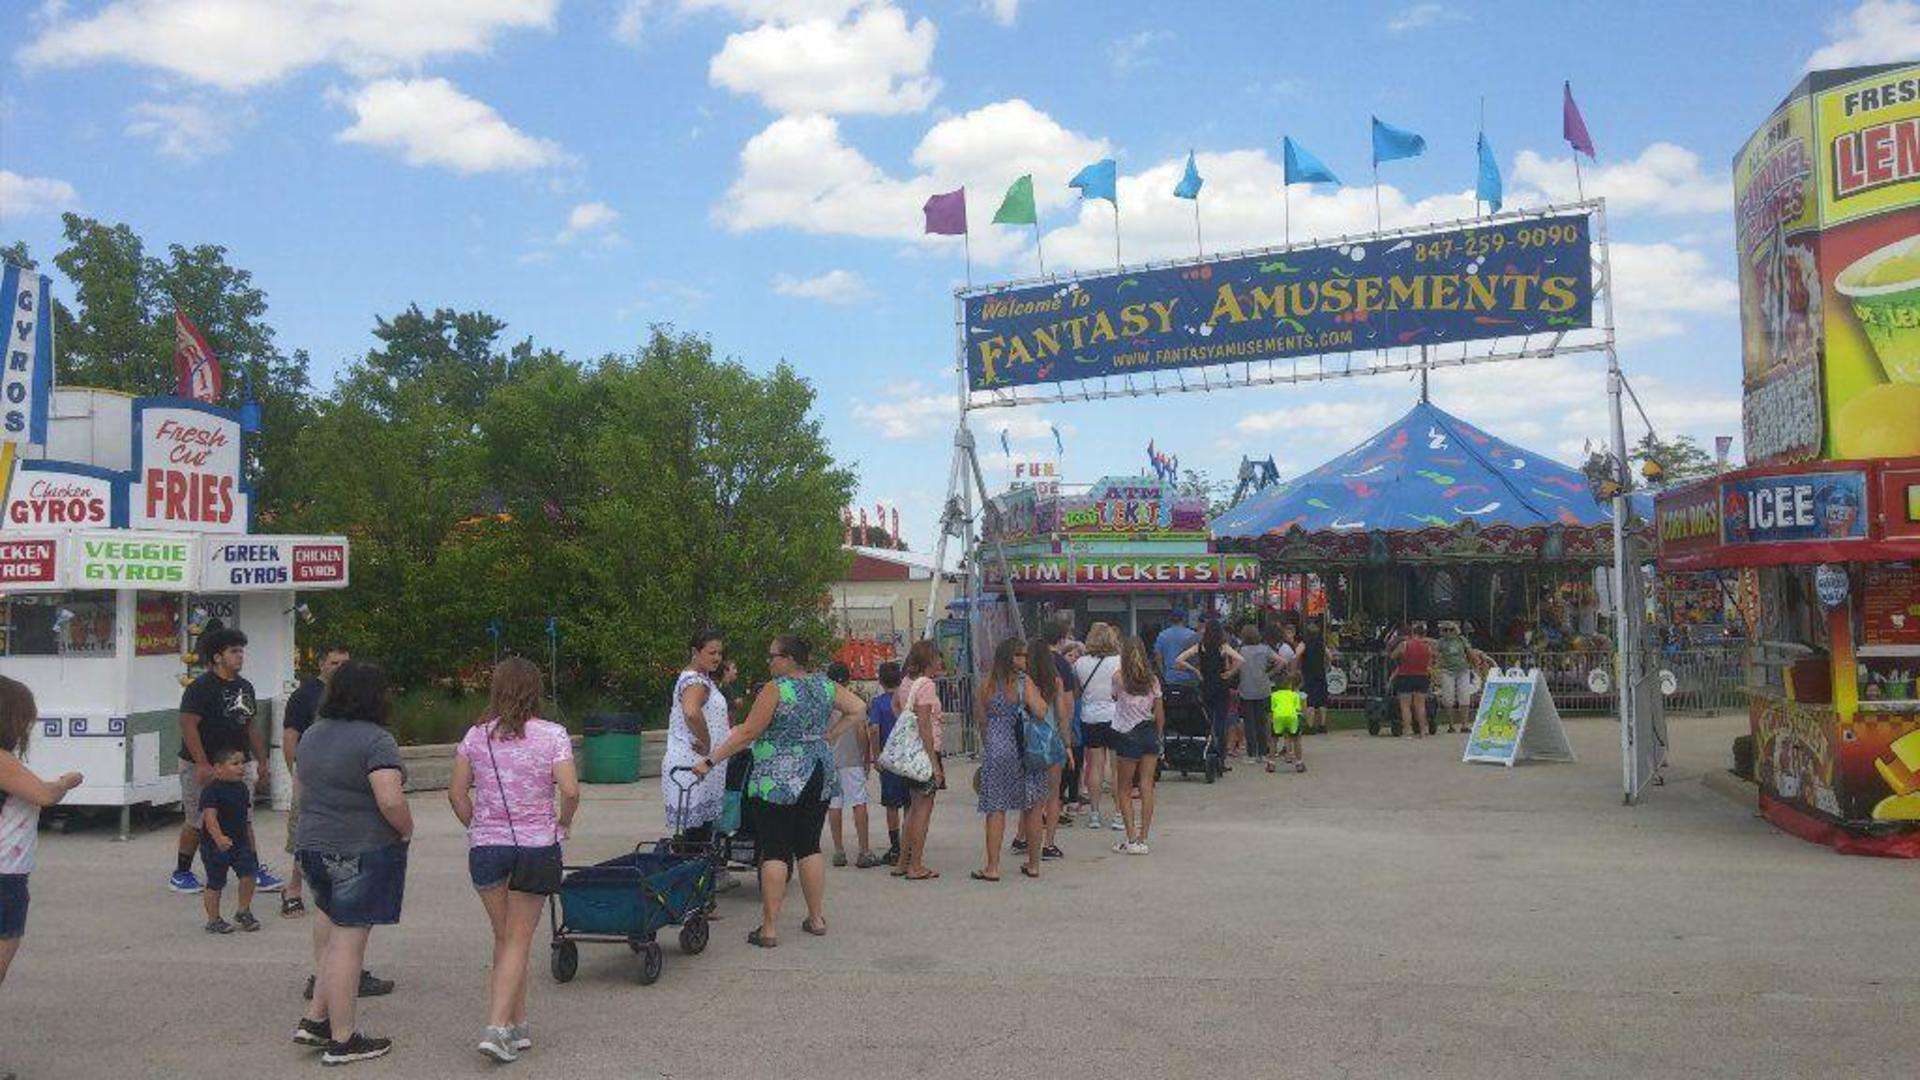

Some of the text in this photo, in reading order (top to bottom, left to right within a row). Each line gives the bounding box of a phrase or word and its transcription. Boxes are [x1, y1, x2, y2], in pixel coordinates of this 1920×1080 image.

[1845, 78, 1920, 117] FRES
[1415, 223, 1579, 263] 847-259-9090
[982, 287, 1090, 320] Welcome To
[977, 272, 1578, 386] FANTASY AMUSEMENTS
[4, 289, 34, 432] GYROS
[155, 418, 229, 448] Fresh
[169, 445, 213, 467] Cut
[1015, 462, 1054, 478] FUN
[29, 479, 93, 500] Chicken
[146, 467, 234, 525] FRIES
[10, 497, 106, 525] GYROS
[1748, 485, 1815, 530] ICEE
[84, 541, 187, 562] VEGGIE
[224, 544, 280, 563] GREEK
[295, 548, 342, 563] CHICKEN
[85, 563, 184, 582] GYROS
[230, 566, 288, 585] GYROS
[301, 564, 337, 578] GYROS
[1009, 562, 1061, 581] ATM
[1083, 562, 1212, 581] TICKETS
[1230, 562, 1260, 581] AT
